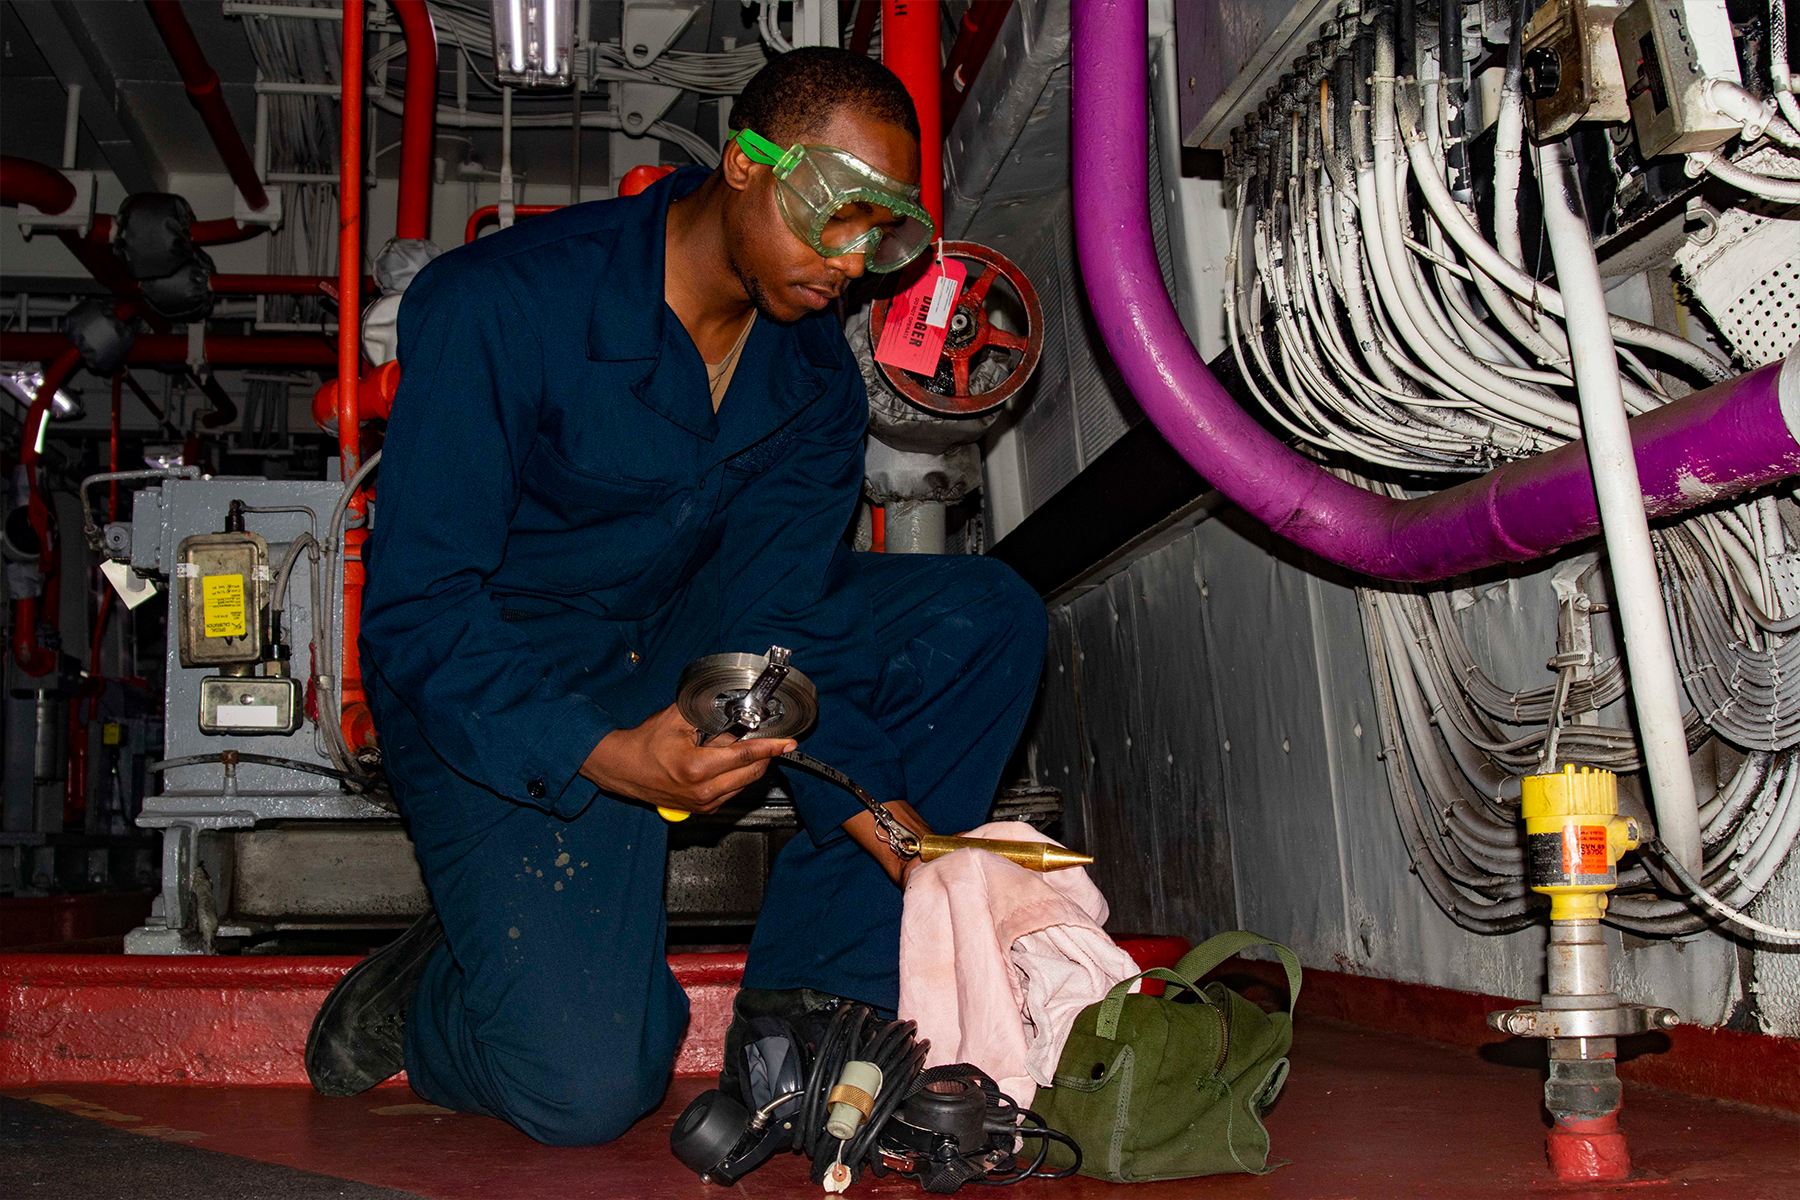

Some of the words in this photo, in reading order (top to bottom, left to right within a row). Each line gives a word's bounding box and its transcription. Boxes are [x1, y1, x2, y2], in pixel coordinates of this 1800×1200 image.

[913, 297, 919, 305] DO
[903, 316, 913, 338] OPERATE
[909, 296, 932, 347] DANGER
